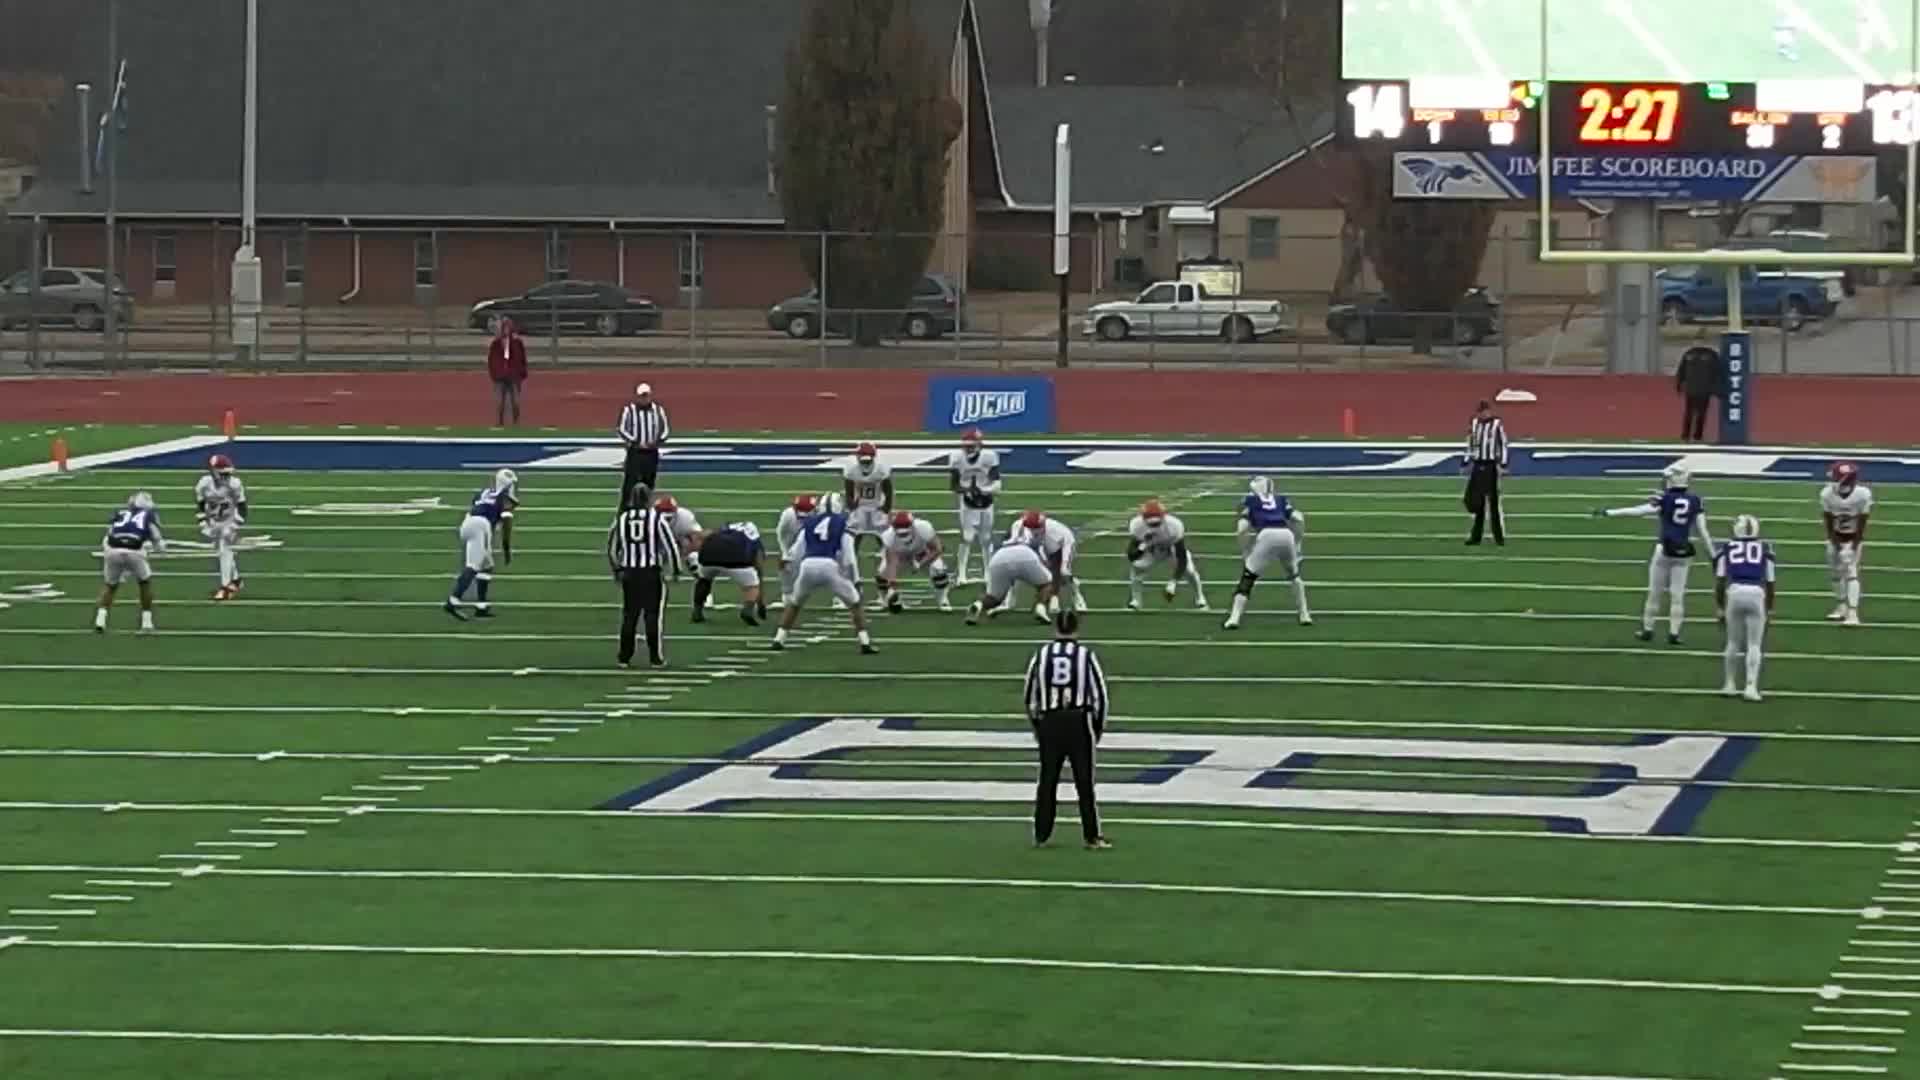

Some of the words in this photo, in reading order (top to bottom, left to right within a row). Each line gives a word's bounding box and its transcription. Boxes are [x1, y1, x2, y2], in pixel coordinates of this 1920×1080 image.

[1347, 84, 1403, 138] 14
[1580, 88, 1679, 141] 2:27
[1506, 157, 1541, 176] JIM
[1552, 157, 1595, 177] FEE
[1600, 157, 1766, 178] SCOREBOARD
[1672, 498, 1691, 525] 2
[813, 515, 830, 542] 4
[1728, 543, 1763, 565] 20
[1051, 656, 1072, 686] B
